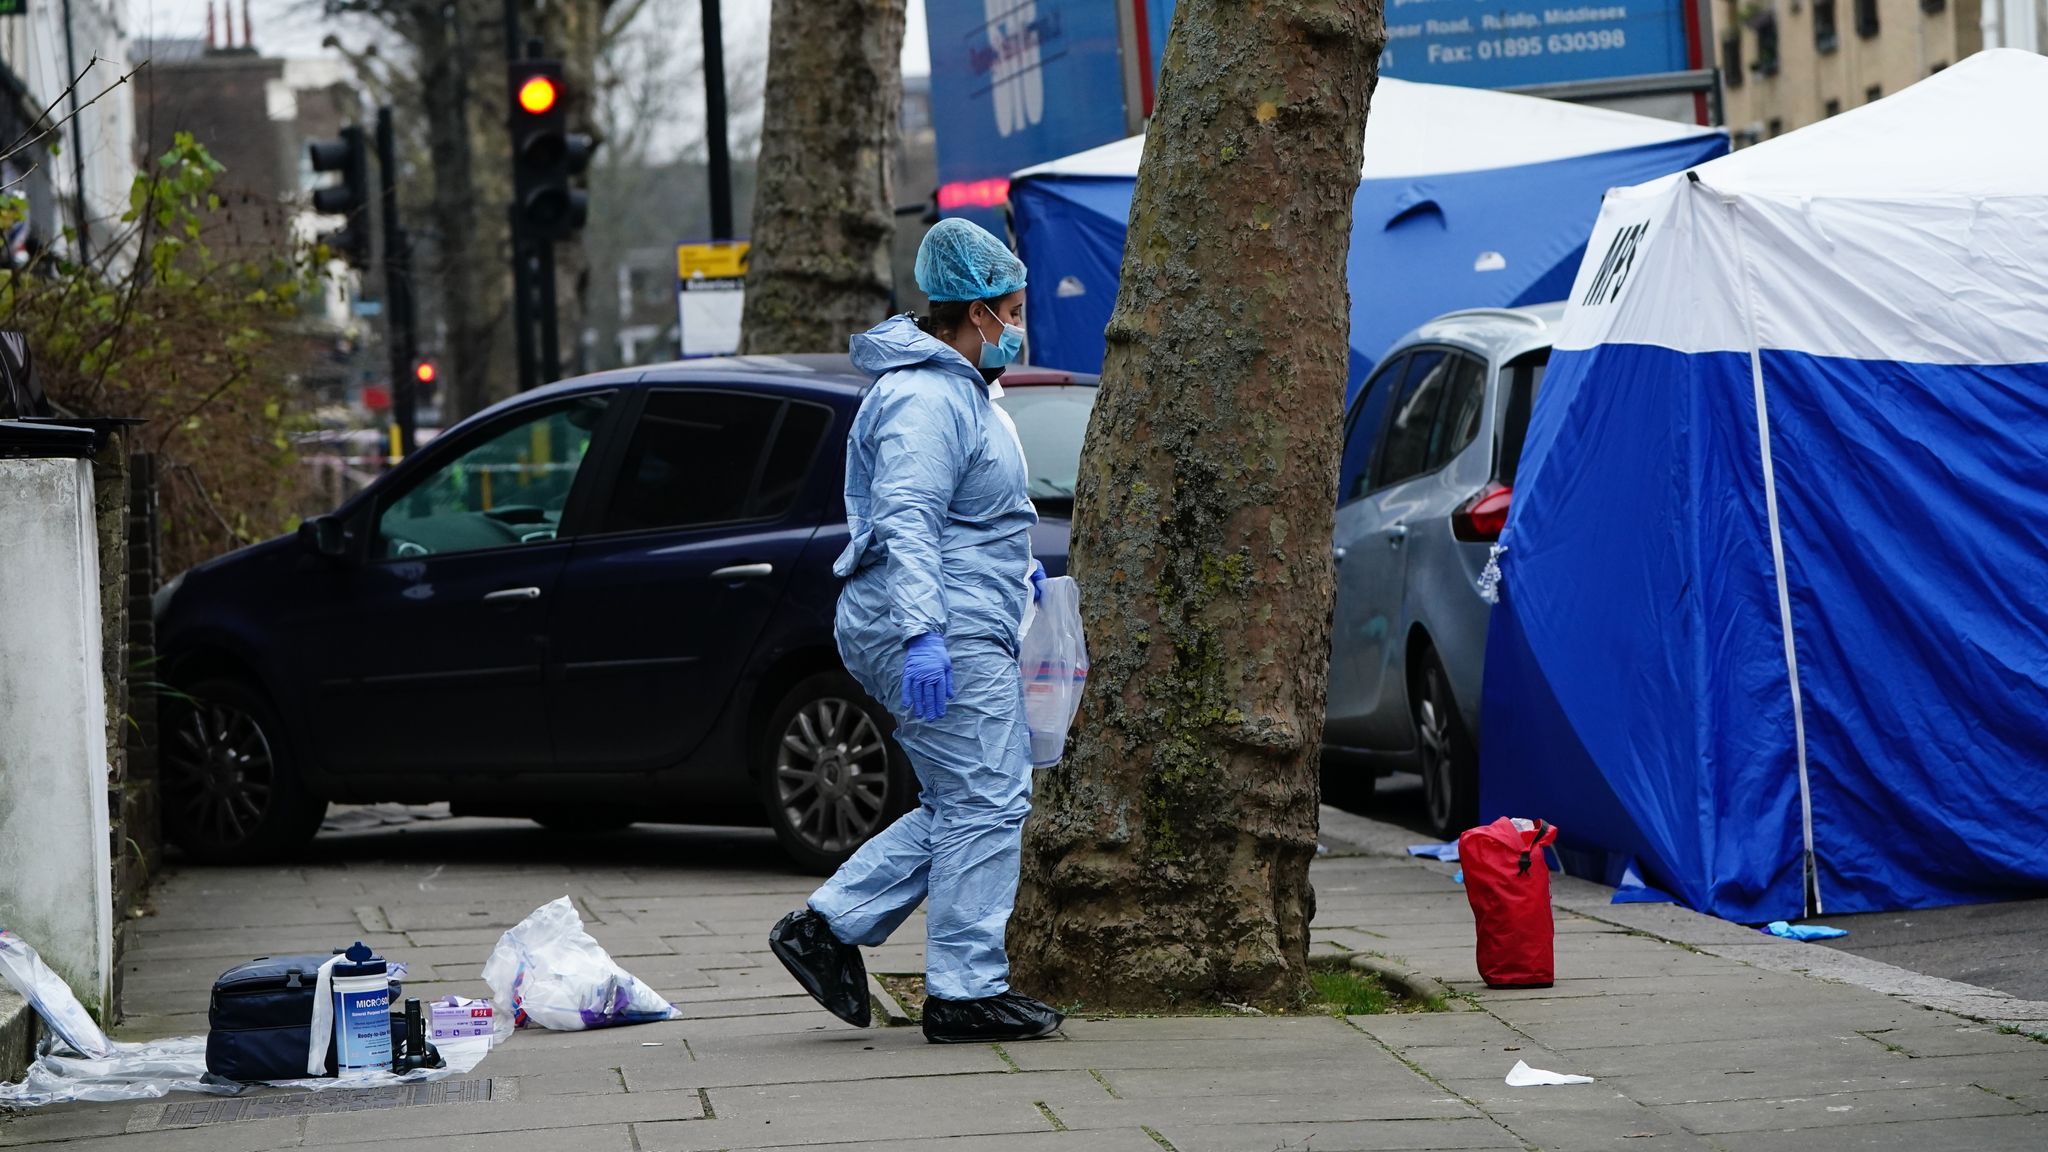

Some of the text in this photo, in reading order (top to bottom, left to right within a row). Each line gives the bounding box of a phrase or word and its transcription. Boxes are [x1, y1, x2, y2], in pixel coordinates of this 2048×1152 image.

[1544, 6, 1626, 24] Middlesex
[1427, 43, 1473, 64] Fax:
[1478, 36, 1542, 59] 01895
[1547, 28, 1625, 54] 630398
[1582, 218, 1650, 306] MPS
